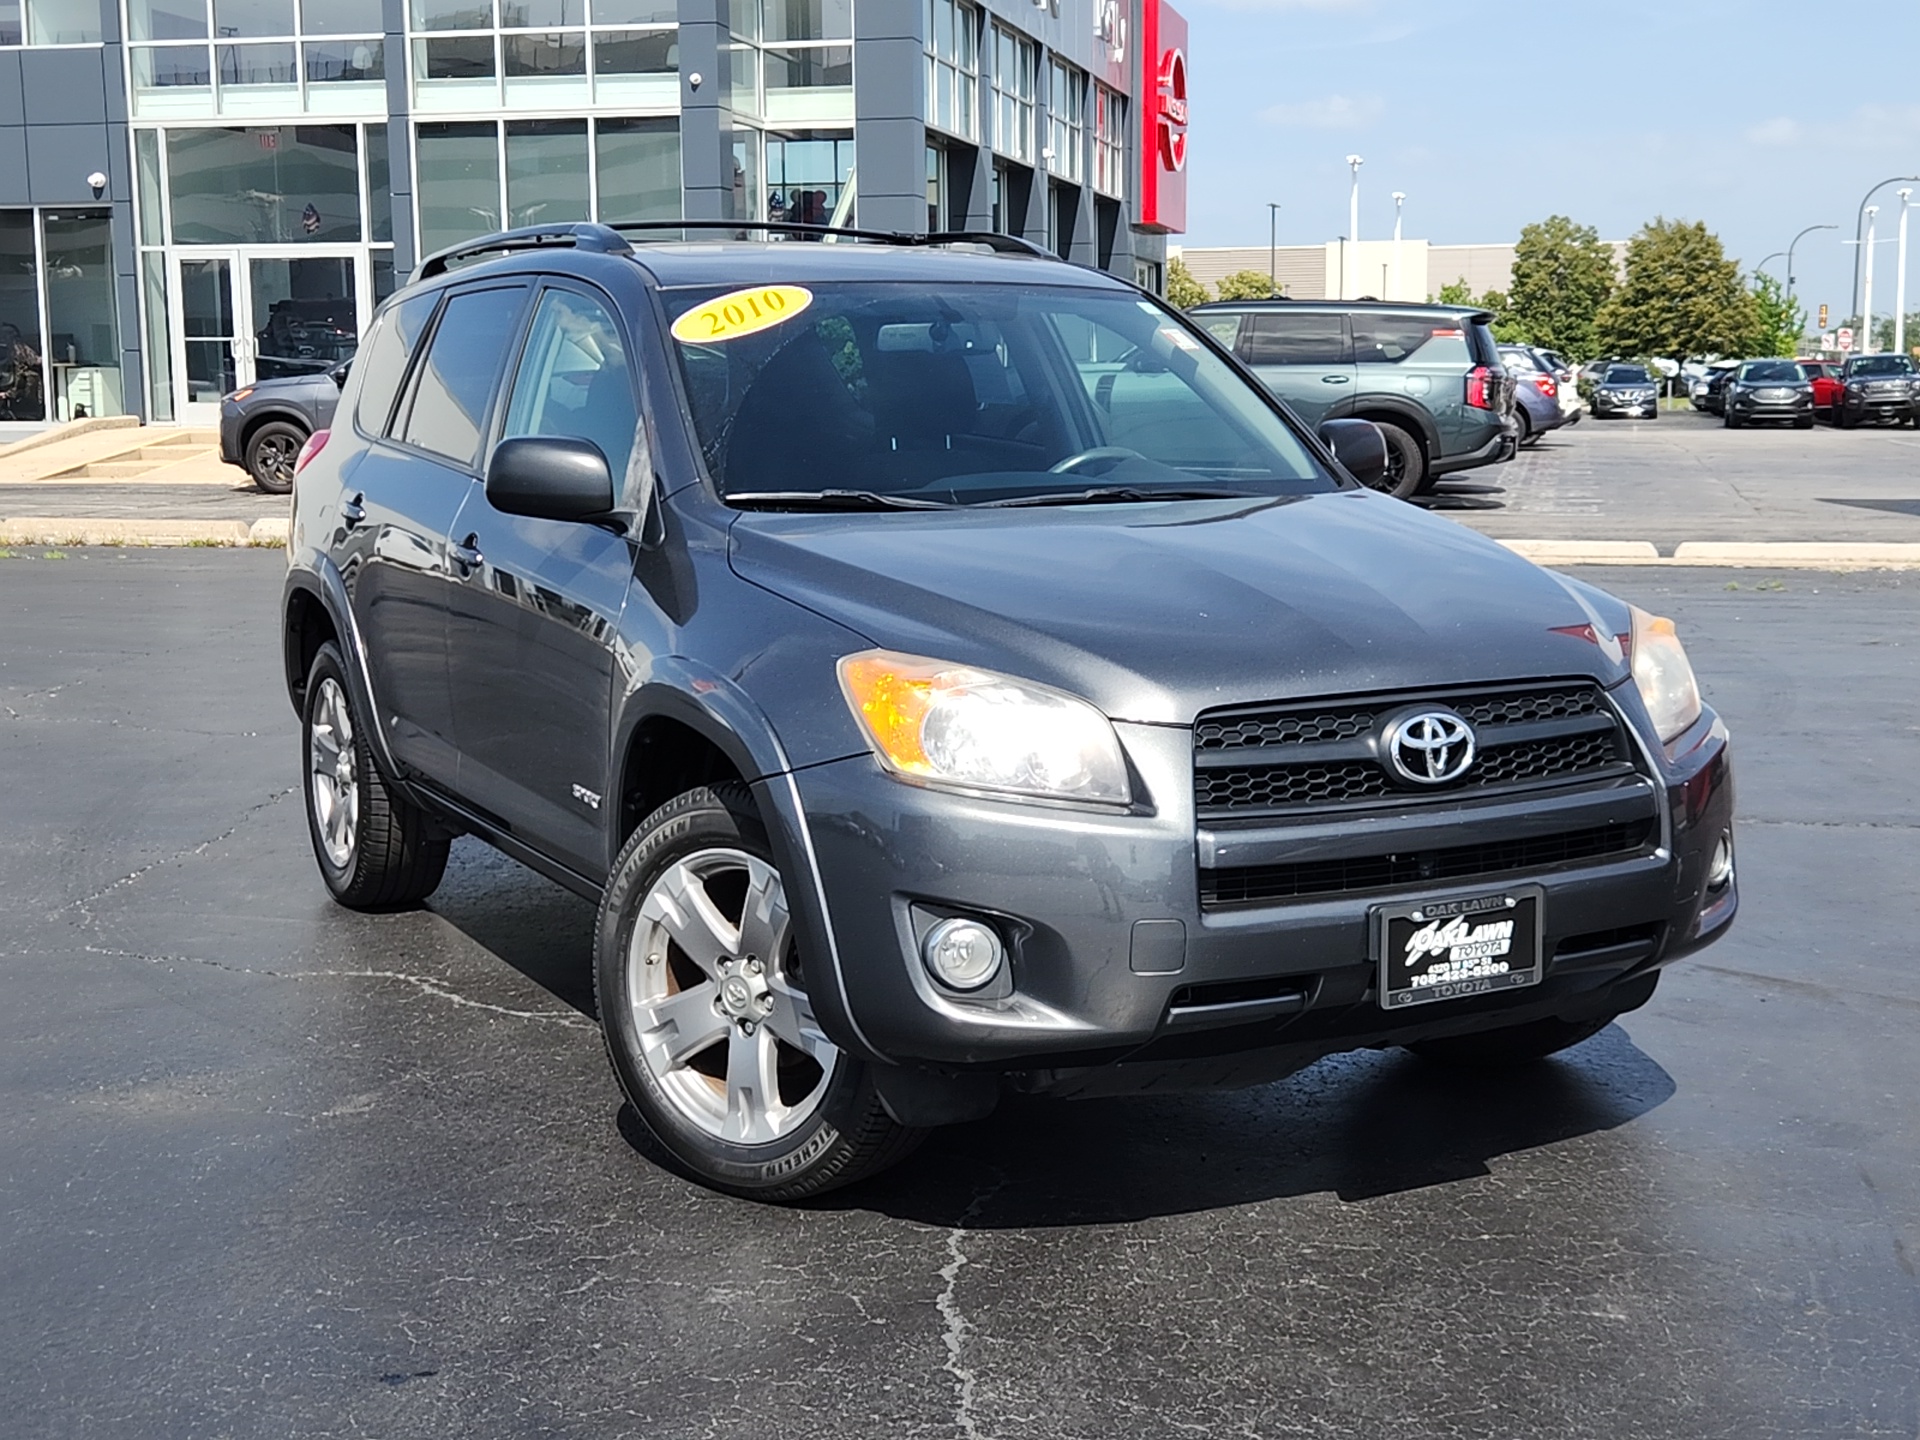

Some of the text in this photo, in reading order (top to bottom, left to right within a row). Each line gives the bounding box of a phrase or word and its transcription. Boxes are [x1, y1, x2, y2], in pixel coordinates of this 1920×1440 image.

[701, 290, 786, 335] 2010
[623, 819, 687, 884] MICHELIN
[1426, 896, 1505, 917] OAK LAWN
[1458, 941, 1502, 957] TOYOTA
[1411, 961, 1510, 988] 708-423-5200
[1432, 979, 1492, 998] TOYOTA
[765, 1123, 836, 1178] MICHELIN
